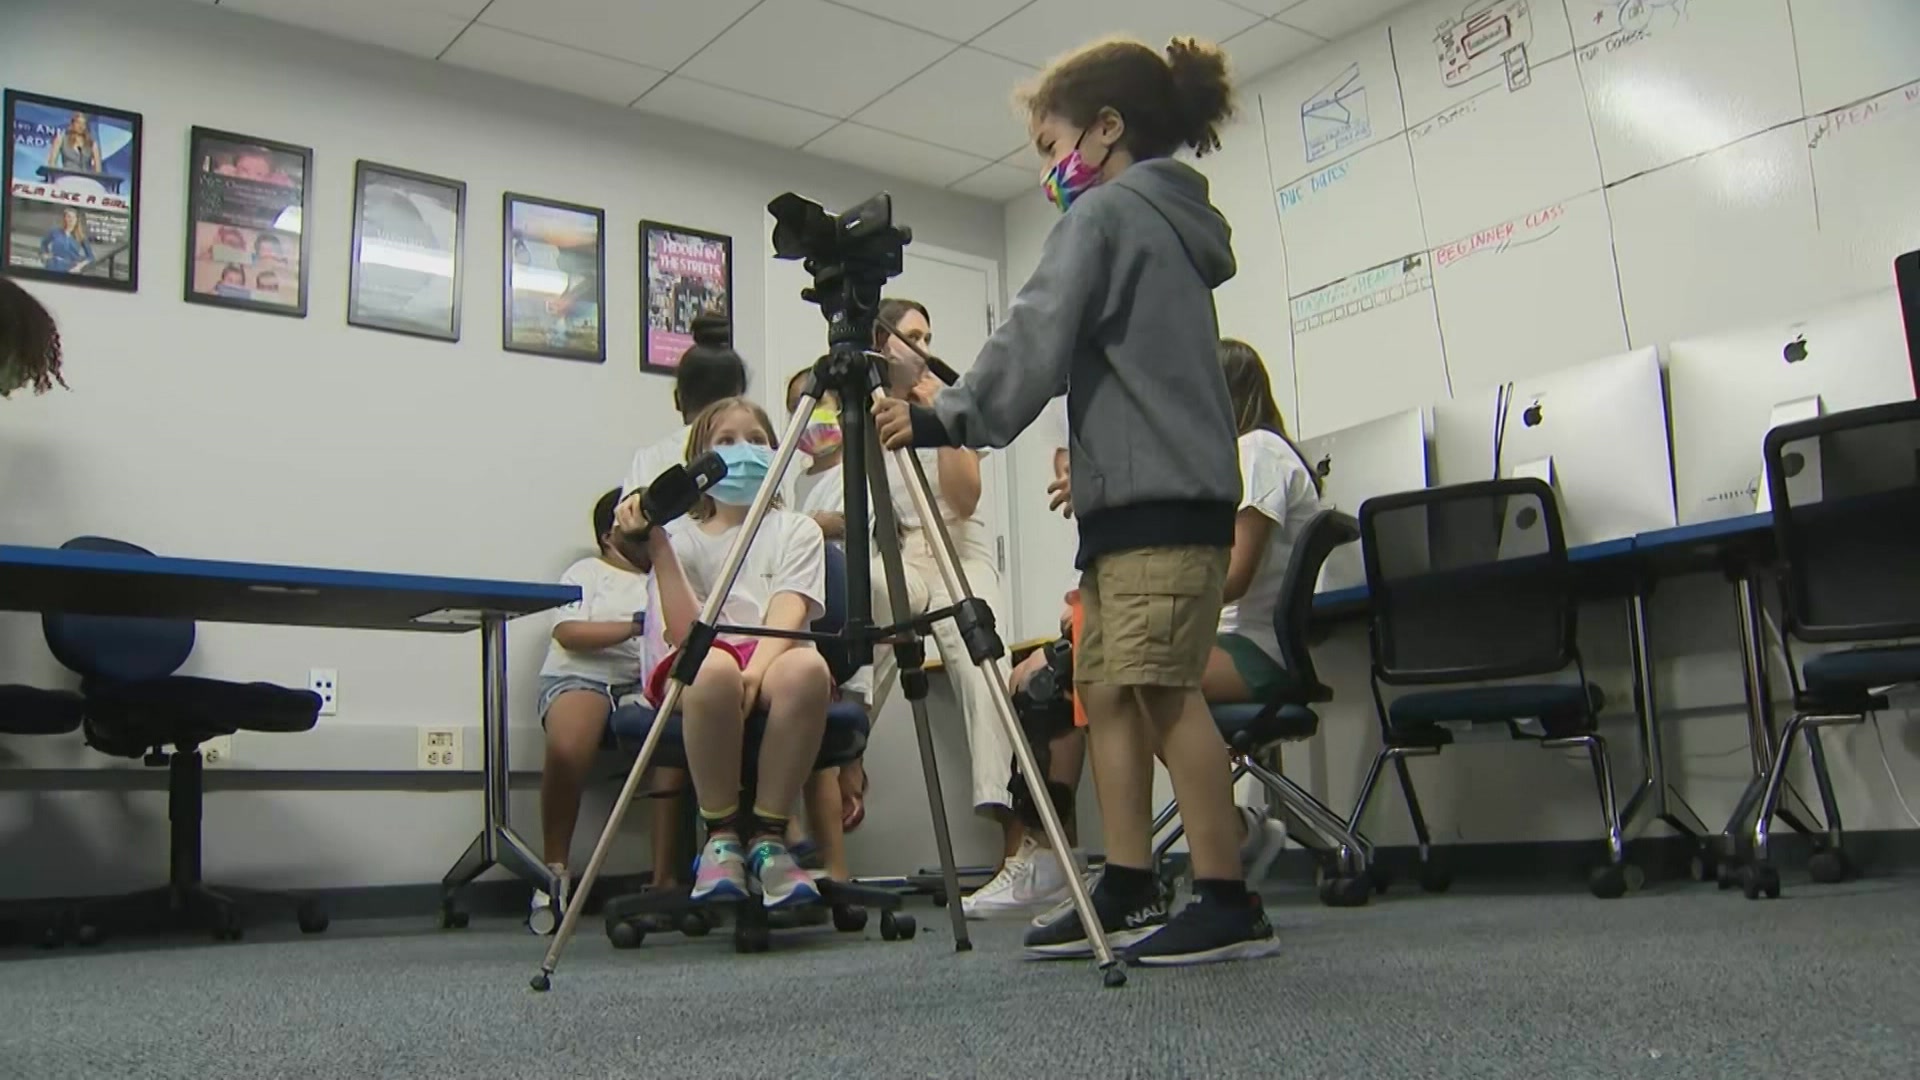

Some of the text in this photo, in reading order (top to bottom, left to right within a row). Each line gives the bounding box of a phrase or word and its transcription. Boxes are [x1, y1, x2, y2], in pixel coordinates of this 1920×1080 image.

[12, 183, 130, 209] FILM LIKE A GIRL
[1437, 204, 1564, 265] BEGINNER CLASS
[704, 245, 718, 261] IN
[659, 254, 722, 277] THE STREETS
